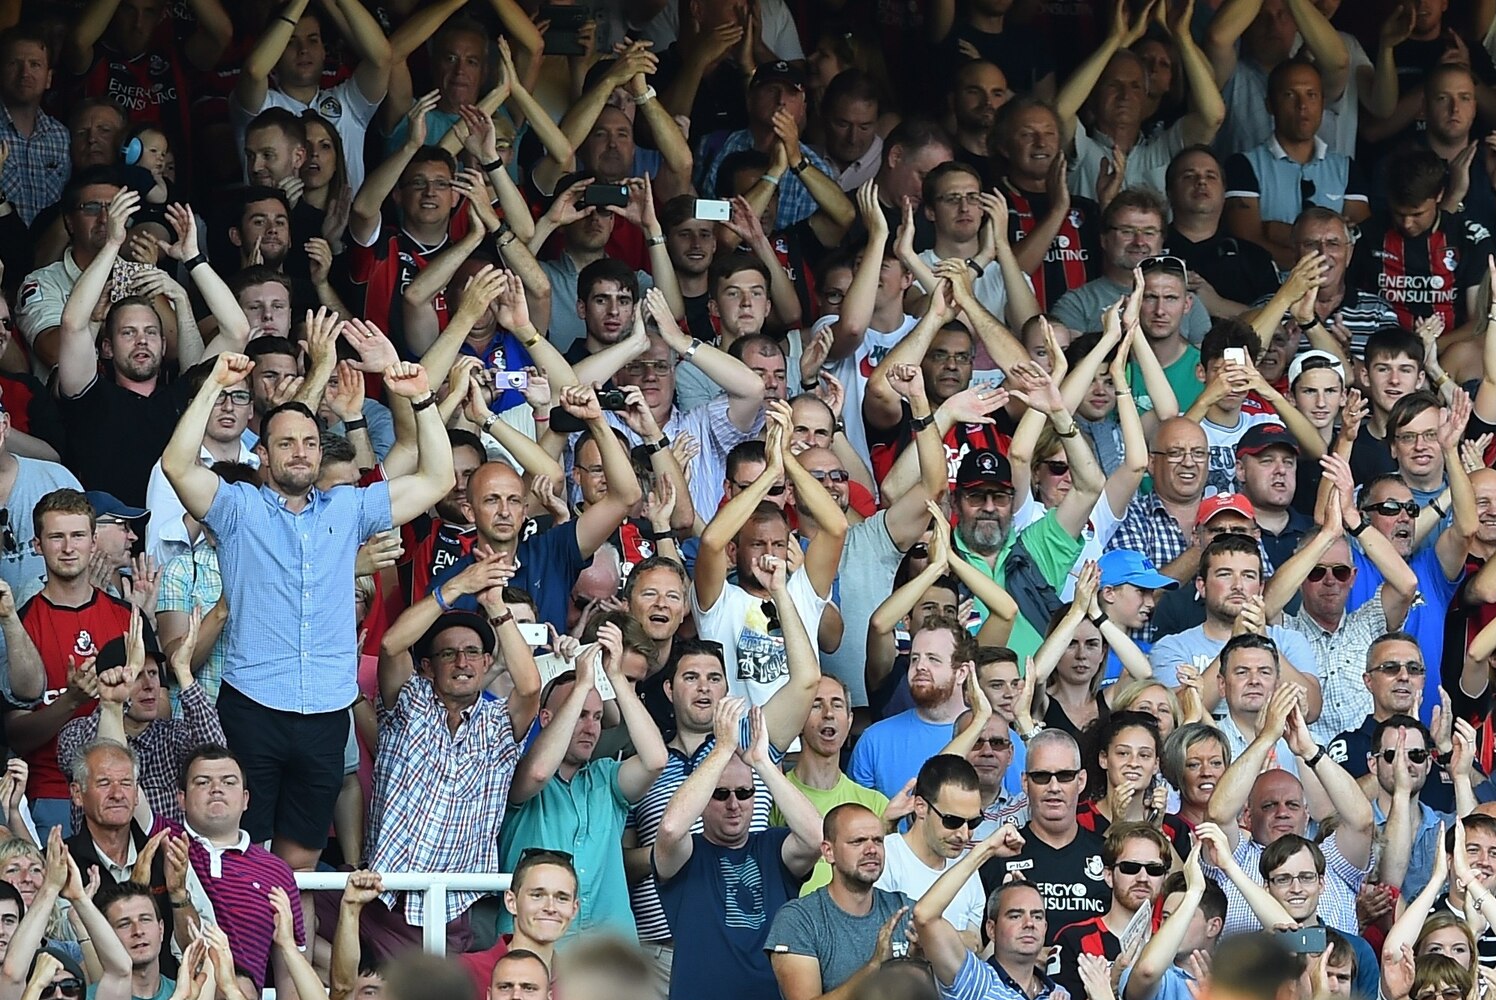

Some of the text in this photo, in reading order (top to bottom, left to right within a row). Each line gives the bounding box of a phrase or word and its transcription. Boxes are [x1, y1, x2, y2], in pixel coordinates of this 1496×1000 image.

[1378, 273, 1430, 288] ENERGY
[1379, 287, 1460, 304] CONSULTING
[1036, 883, 1066, 896] ERGY
[1044, 897, 1104, 913] NSULTING
